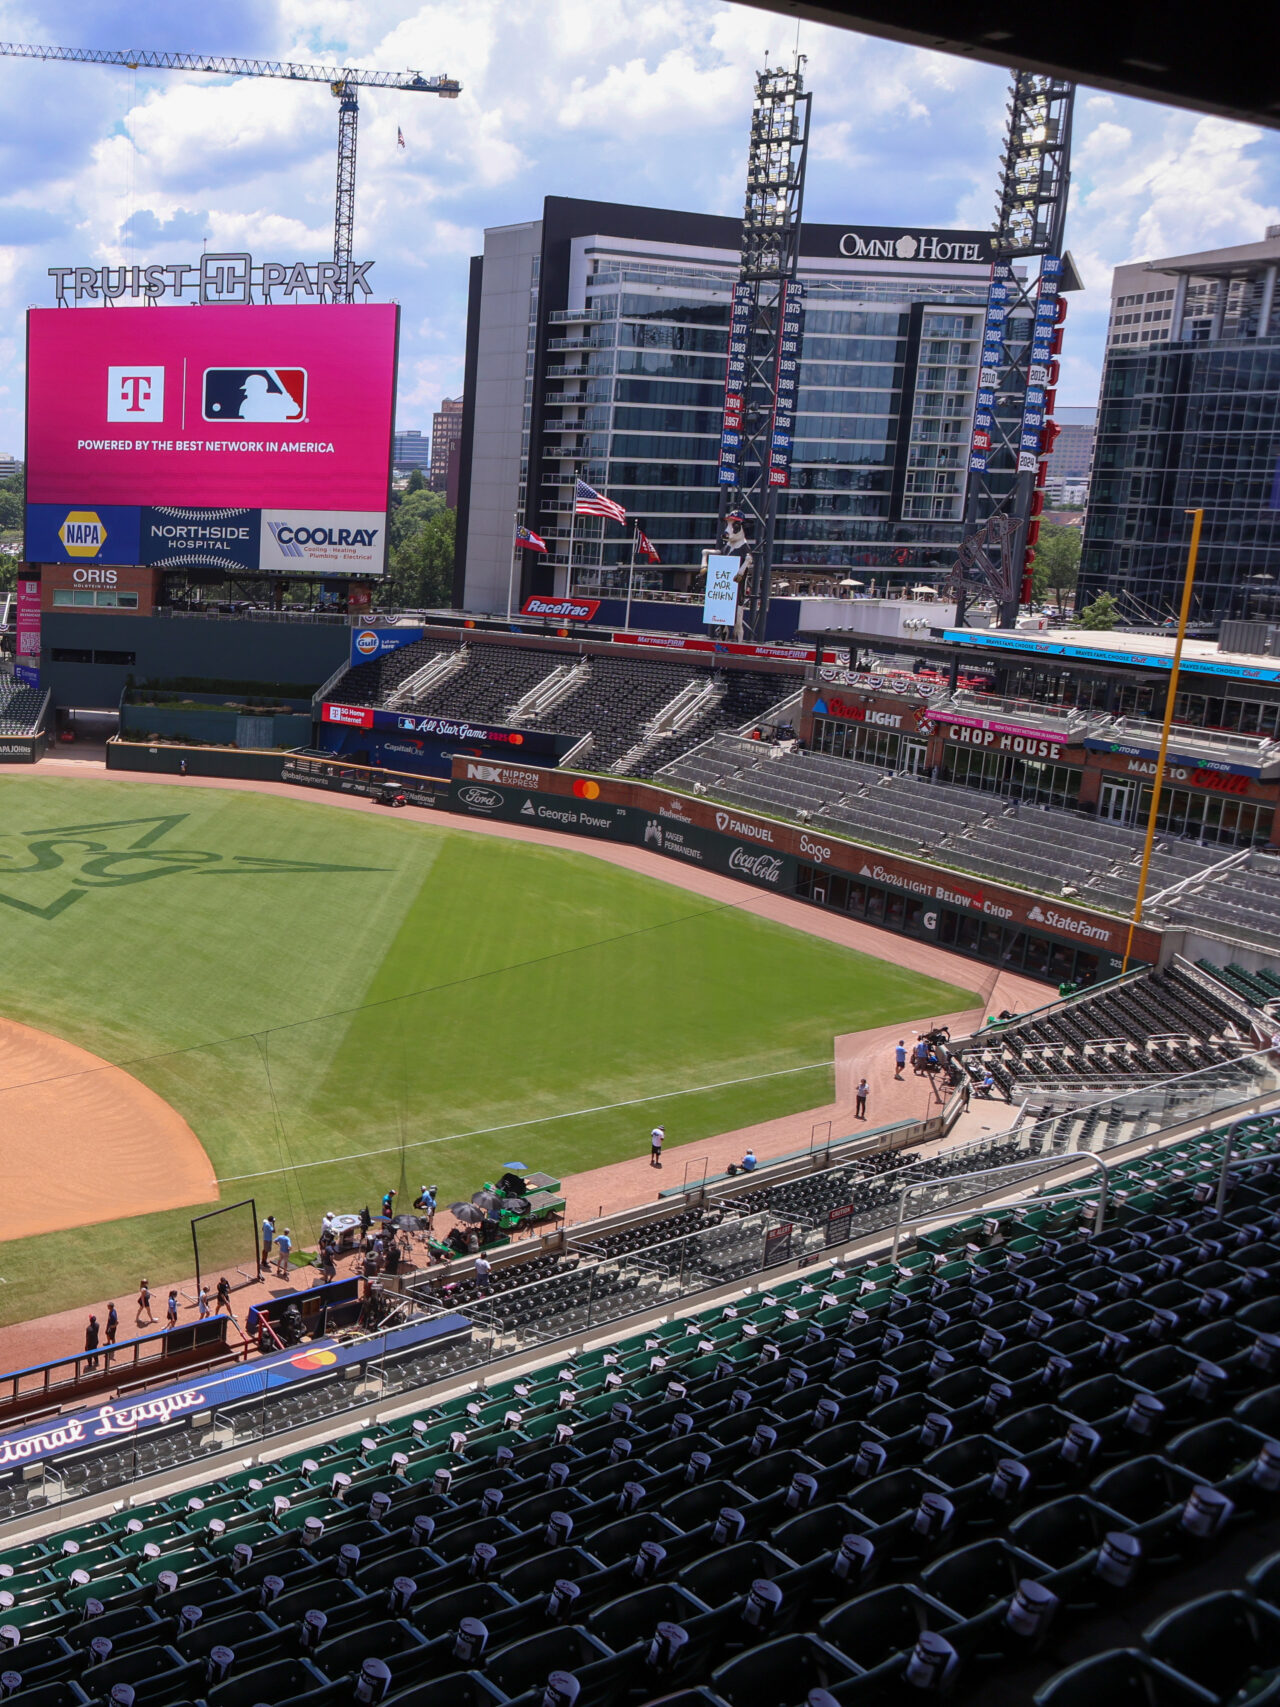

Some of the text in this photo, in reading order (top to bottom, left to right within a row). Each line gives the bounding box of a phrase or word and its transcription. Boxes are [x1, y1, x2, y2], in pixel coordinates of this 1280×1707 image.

[1044, 259, 1058, 272] 1997
[994, 266, 1008, 278] 1996
[48, 261, 375, 299] TRUIST PARK
[736, 286, 750, 296] 1872
[787, 284, 802, 294] 1873
[734, 304, 749, 316] 1874
[786, 304, 800, 314] 1875
[732, 324, 747, 334] 1877
[784, 322, 798, 332] 1878
[782, 341, 796, 352] 1891
[730, 361, 744, 372] 1892
[728, 380, 742, 390] 1897
[726, 398, 740, 409] 1914
[724, 416, 739, 427] 1957
[776, 416, 790, 427] 1958
[78, 440, 334, 453] POWERED BY THE BEST NETWORK IN AMERICA
[774, 436, 788, 446] 1982
[722, 452, 736, 463] 1991
[772, 454, 787, 464] 1992
[770, 472, 785, 483] 1995
[67, 524, 99, 544] NAPA
[151, 525, 250, 539] NORTHSIDE
[277, 527, 379, 546] COOLRAY
[168, 540, 230, 549] HOSPITAL
[73, 569, 118, 583] ORIS
[716, 571, 731, 580] EAT
[714, 581, 730, 590] MOR
[708, 591, 734, 600] CHIKIN
[527, 600, 589, 616] RaceTrac
[358, 639, 377, 647] Gulf
[828, 698, 866, 721] Coors
[865, 710, 903, 728] LIGHT
[341, 716, 362, 724] Internet
[416, 720, 508, 742] All Star Game 2025
[950, 726, 1060, 760] CHOP HOUSE
[502, 770, 539, 781] NIPPON
[1170, 768, 1187, 779] TO
[502, 776, 539, 789] EXPRESS
[1190, 770, 1250, 794] Chill
[409, 794, 436, 803] National
[466, 788, 496, 806] Ford
[538, 806, 612, 828] Georgia Power
[659, 807, 692, 824] Budweiser
[730, 820, 774, 843] FANDUEL
[665, 832, 684, 843] KAISER
[664, 842, 701, 859] PERMANENTE
[800, 835, 831, 863] Sage
[872, 866, 903, 887] Coors
[904, 881, 933, 896] LIGHT
[924, 912, 936, 929] G
[1110, 958, 1122, 969] 325
[95, 1389, 205, 1436] League
